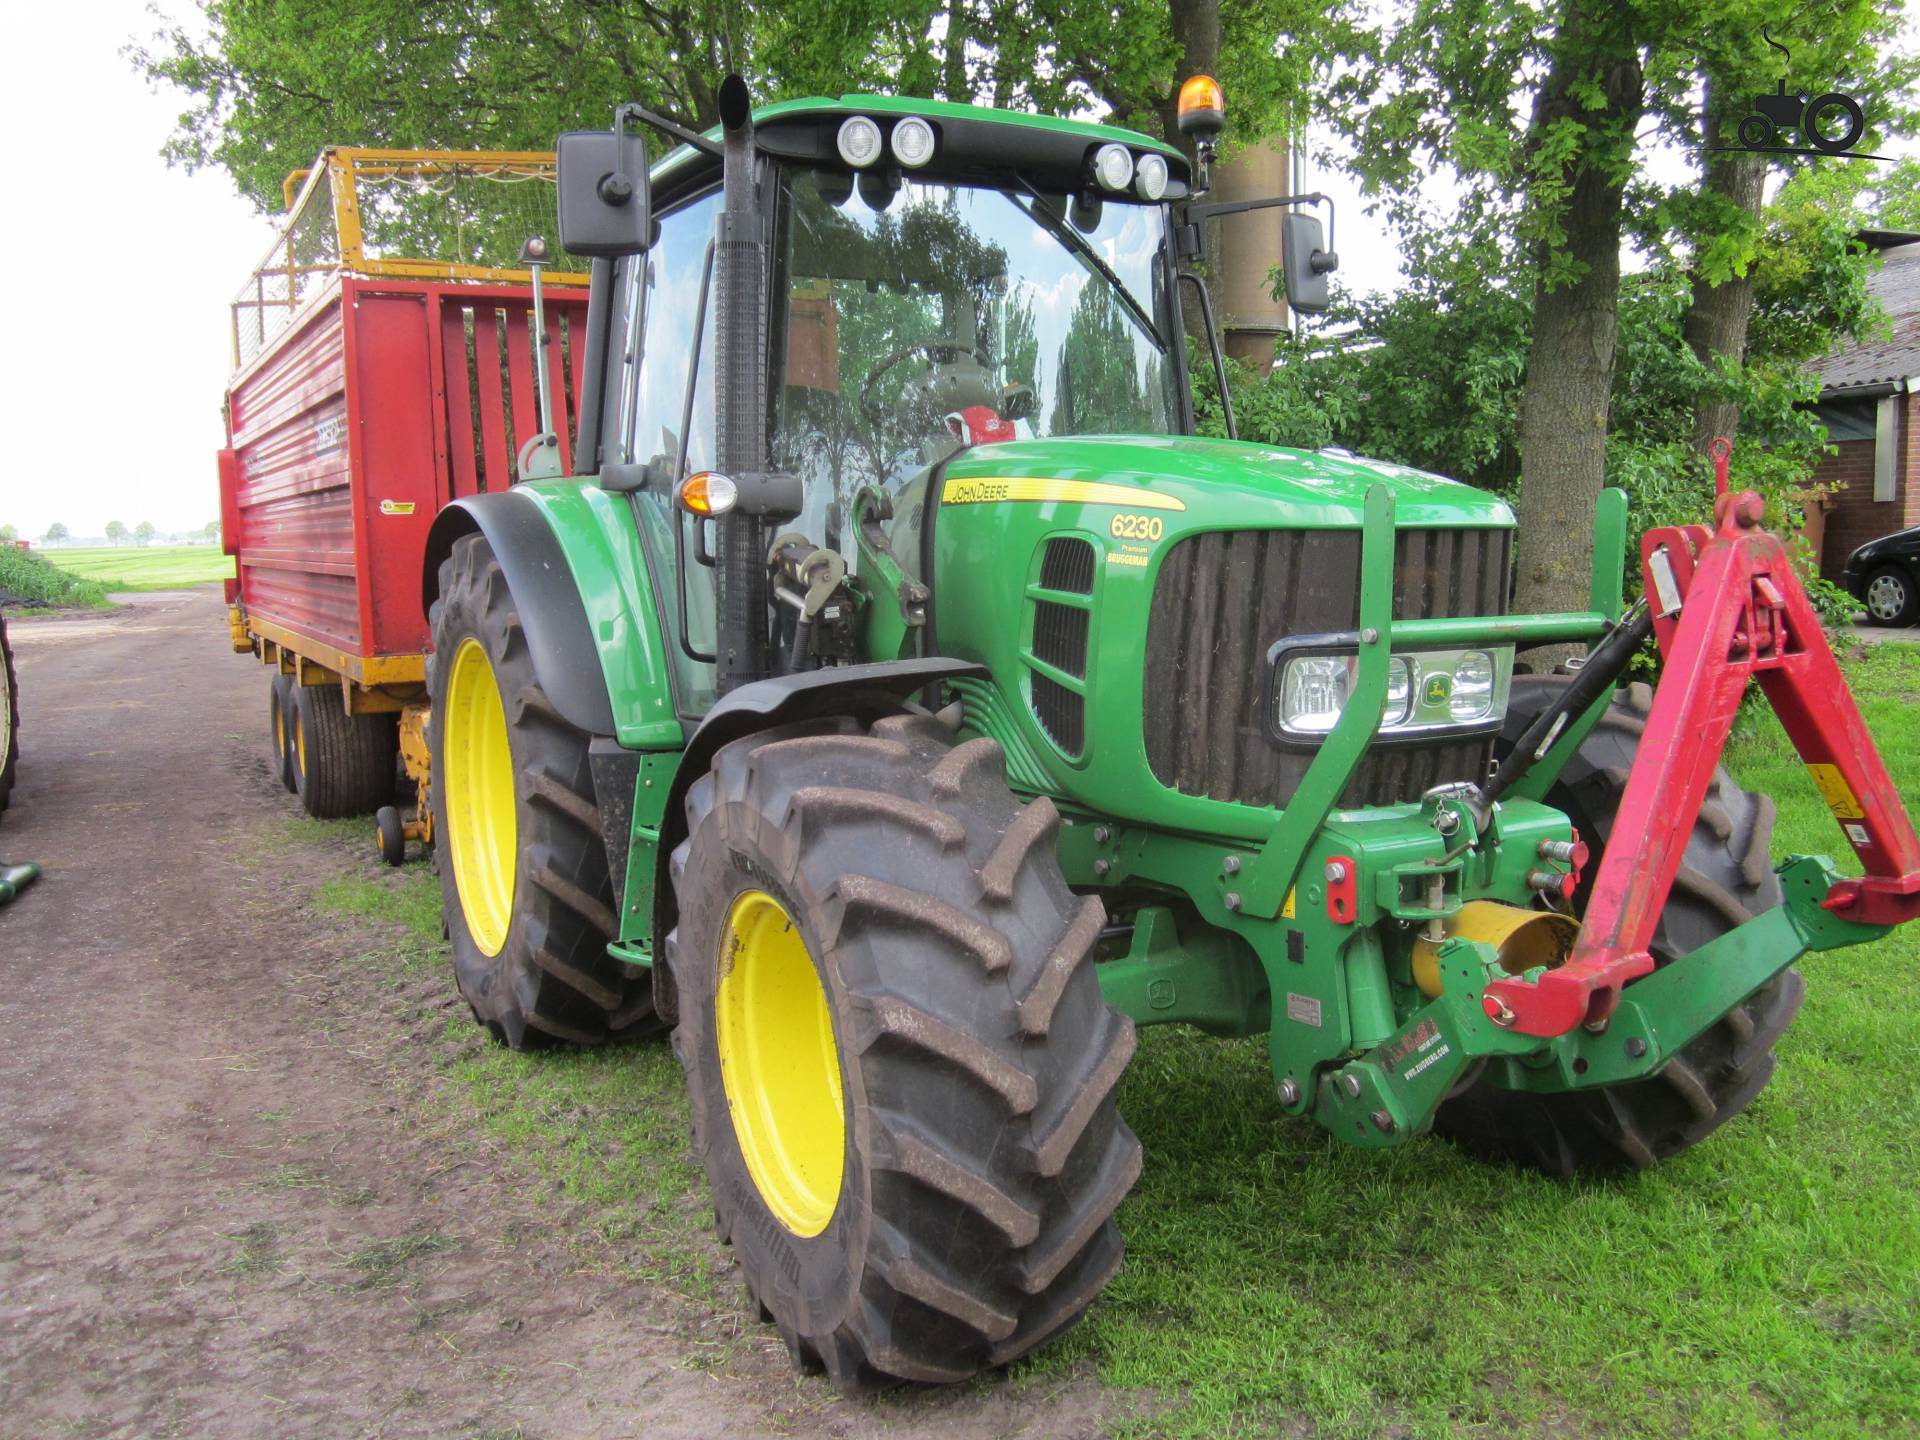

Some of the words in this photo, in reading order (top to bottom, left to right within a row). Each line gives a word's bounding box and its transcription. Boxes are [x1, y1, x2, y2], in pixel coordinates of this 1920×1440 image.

[952, 485, 977, 501] JOHN
[976, 482, 1009, 499] DEERE
[1110, 512, 1163, 541] 6230
